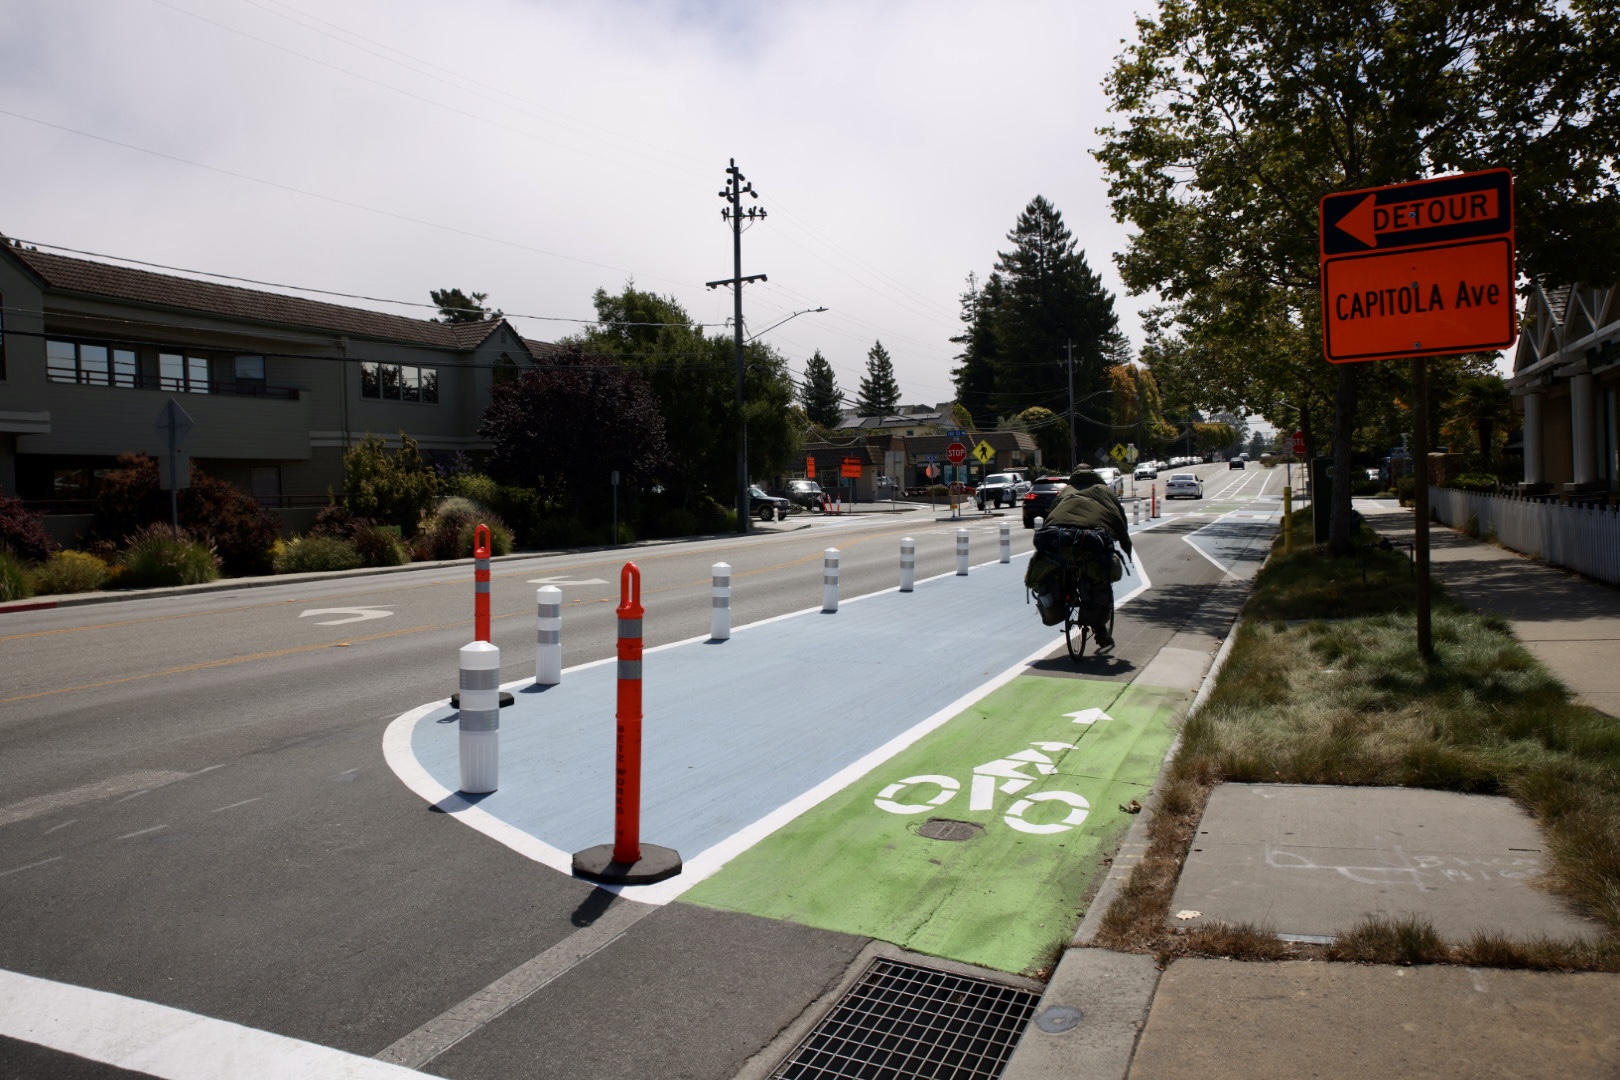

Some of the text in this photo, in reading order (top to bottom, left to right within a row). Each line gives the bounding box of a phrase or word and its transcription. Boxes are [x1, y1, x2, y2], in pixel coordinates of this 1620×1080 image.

[1373, 194, 1488, 231] DETOUR
[1336, 281, 1500, 321] CAPITOLA Ave
[948, 449, 965, 457] STOP
